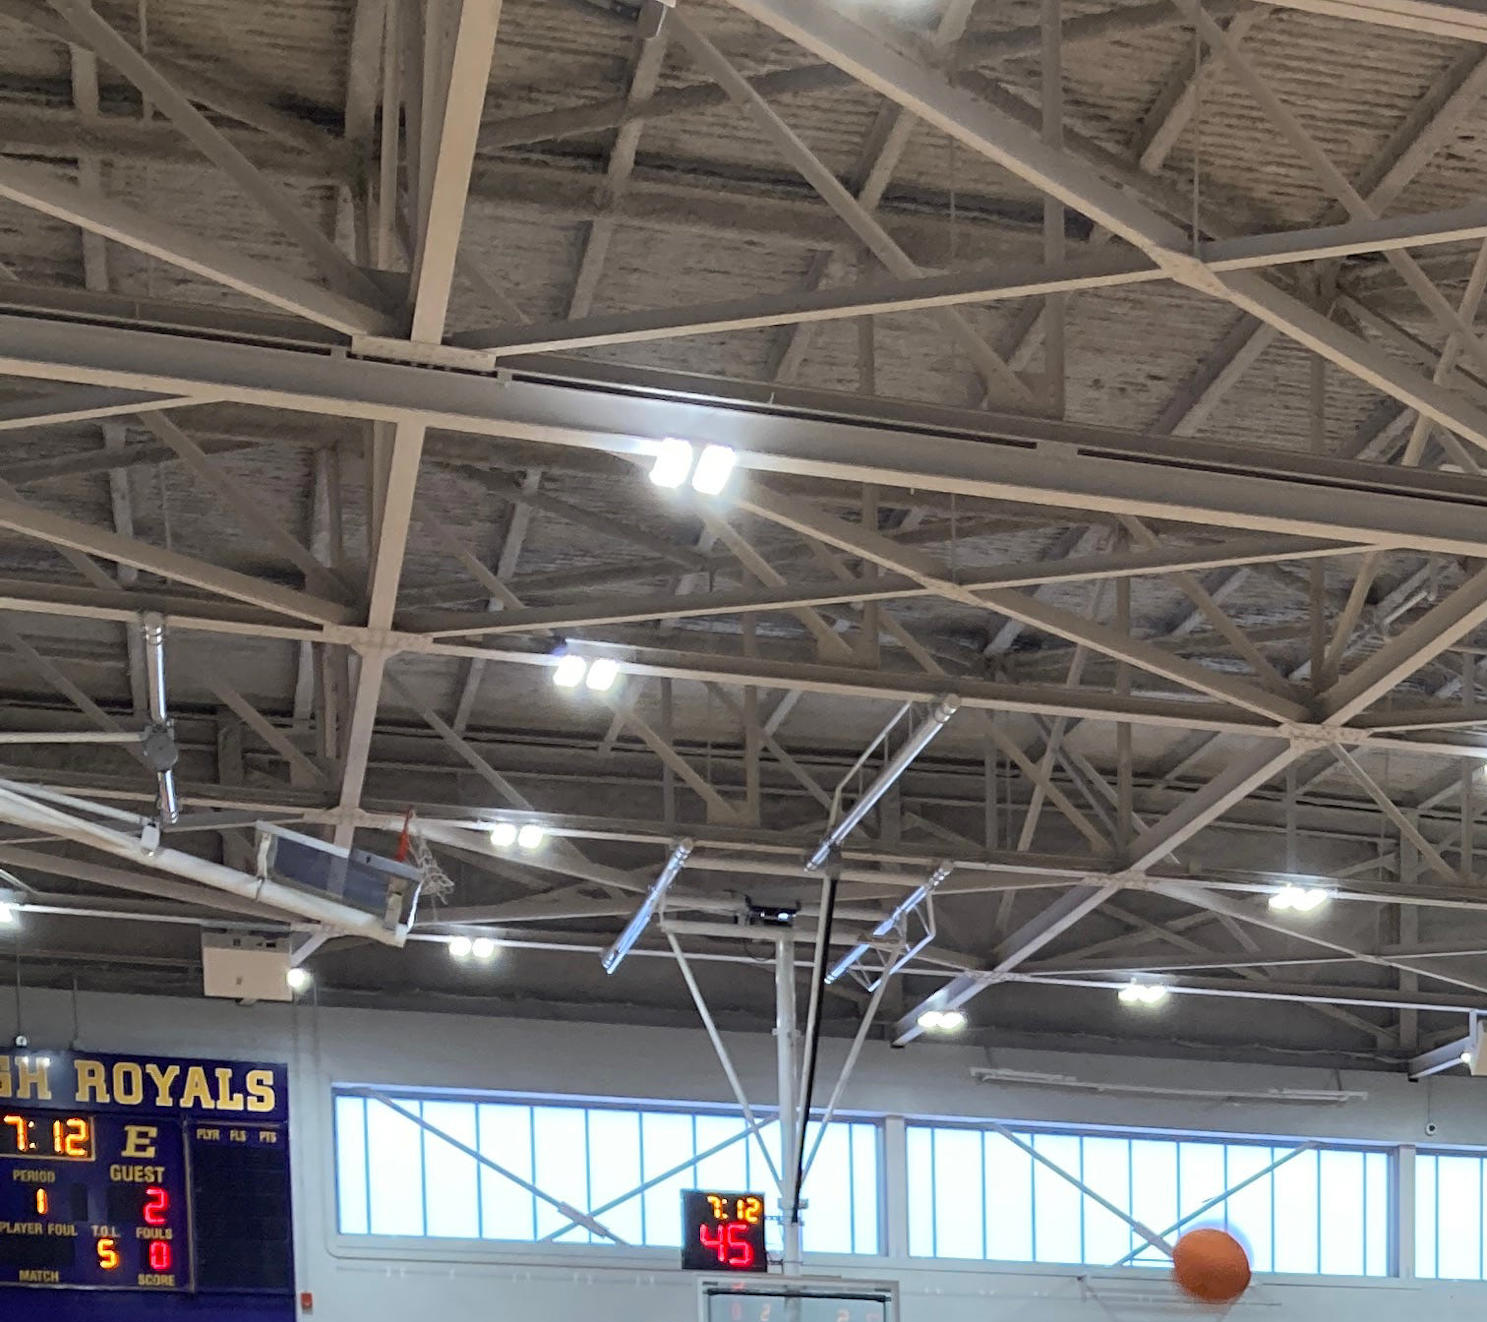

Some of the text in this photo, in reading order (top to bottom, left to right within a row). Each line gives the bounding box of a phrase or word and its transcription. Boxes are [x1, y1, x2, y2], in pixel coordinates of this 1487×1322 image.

[73, 1059, 276, 1113] ROYALS
[3, 1114, 88, 1156] 7:12
[121, 1124, 158, 1158] E
[12, 1169, 56, 1183] PERIOD
[109, 1164, 166, 1184] GUEST
[36, 1187, 48, 1214] 1
[143, 1186, 169, 1226] 2
[705, 1194, 763, 1224] 7:12
[0, 1221, 79, 1237] PLAYER FOUL
[135, 1226, 174, 1240] FOULS
[97, 1237, 120, 1270] 5
[149, 1240, 171, 1271] 0
[699, 1224, 755, 1266] 45
[19, 1269, 60, 1283] MATCH
[137, 1274, 176, 1287] SCORE
